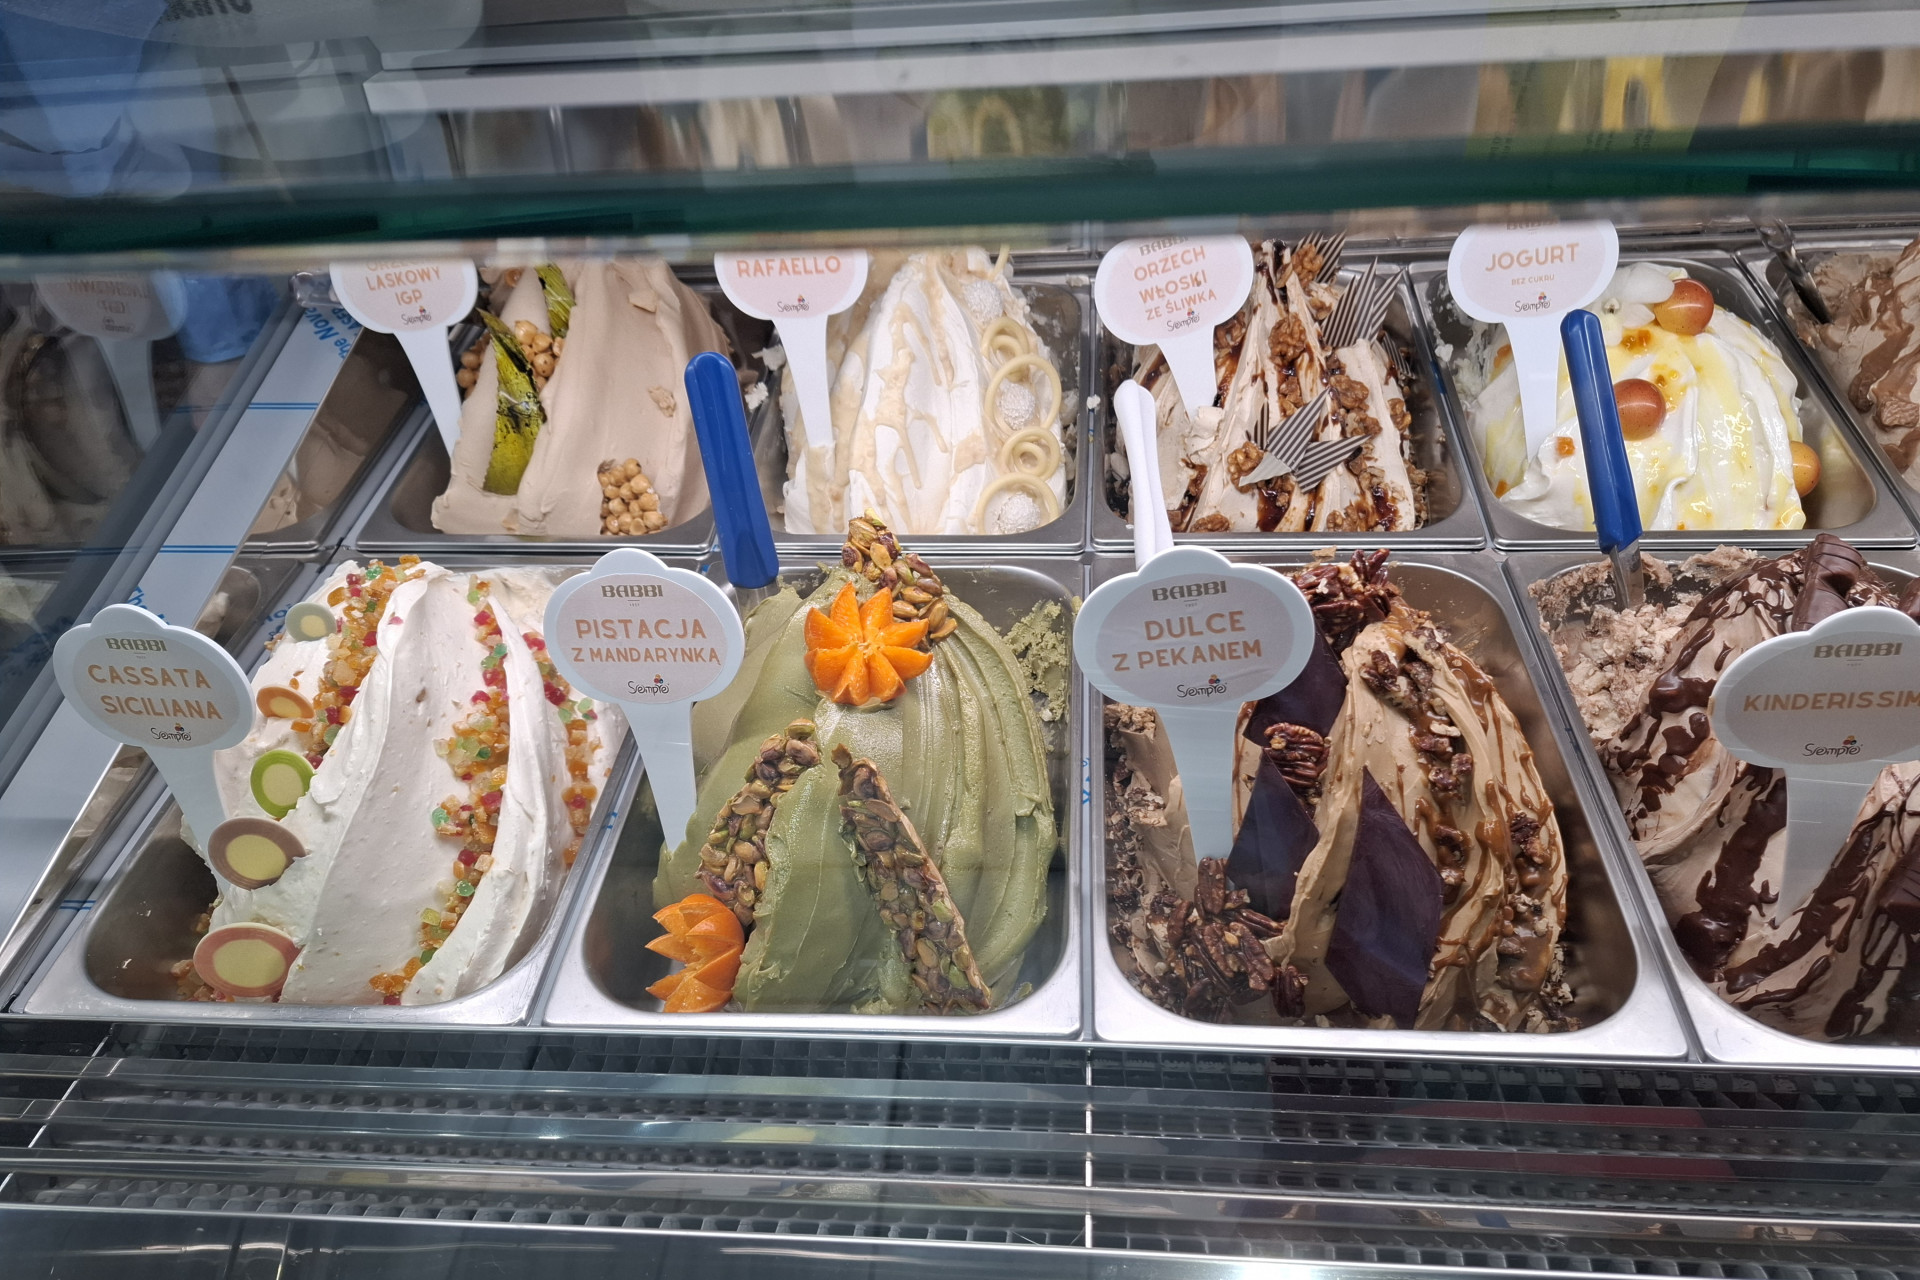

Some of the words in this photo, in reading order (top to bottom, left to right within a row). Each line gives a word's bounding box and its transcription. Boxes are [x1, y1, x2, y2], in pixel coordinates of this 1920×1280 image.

[736, 256, 841, 278] RAFAELLO
[1134, 245, 1206, 281] ORZECH
[1485, 242, 1579, 272] JOGURT
[366, 266, 441, 291] LASKOWY
[1139, 269, 1207, 304] WŁOSKI
[1511, 278, 1526, 286] BEZ
[1528, 274, 1555, 284] CUKRU
[396, 289, 423, 306] IGP
[1145, 308, 1162, 321] ZE
[601, 584, 663, 598] BABBI
[1151, 580, 1227, 601] BABBI
[575, 618, 707, 639] PISTACJA
[1144, 610, 1246, 641] DULCE
[105, 638, 167, 652] BABBI
[1112, 653, 1130, 672] Z
[1137, 639, 1262, 669] PEKANEM
[1813, 642, 1903, 658] BABBI
[571, 647, 585, 663] Z
[589, 647, 721, 666] MANDARYNKĄ
[87, 664, 212, 689] CASSATA
[100, 695, 223, 720] SICILIANA
